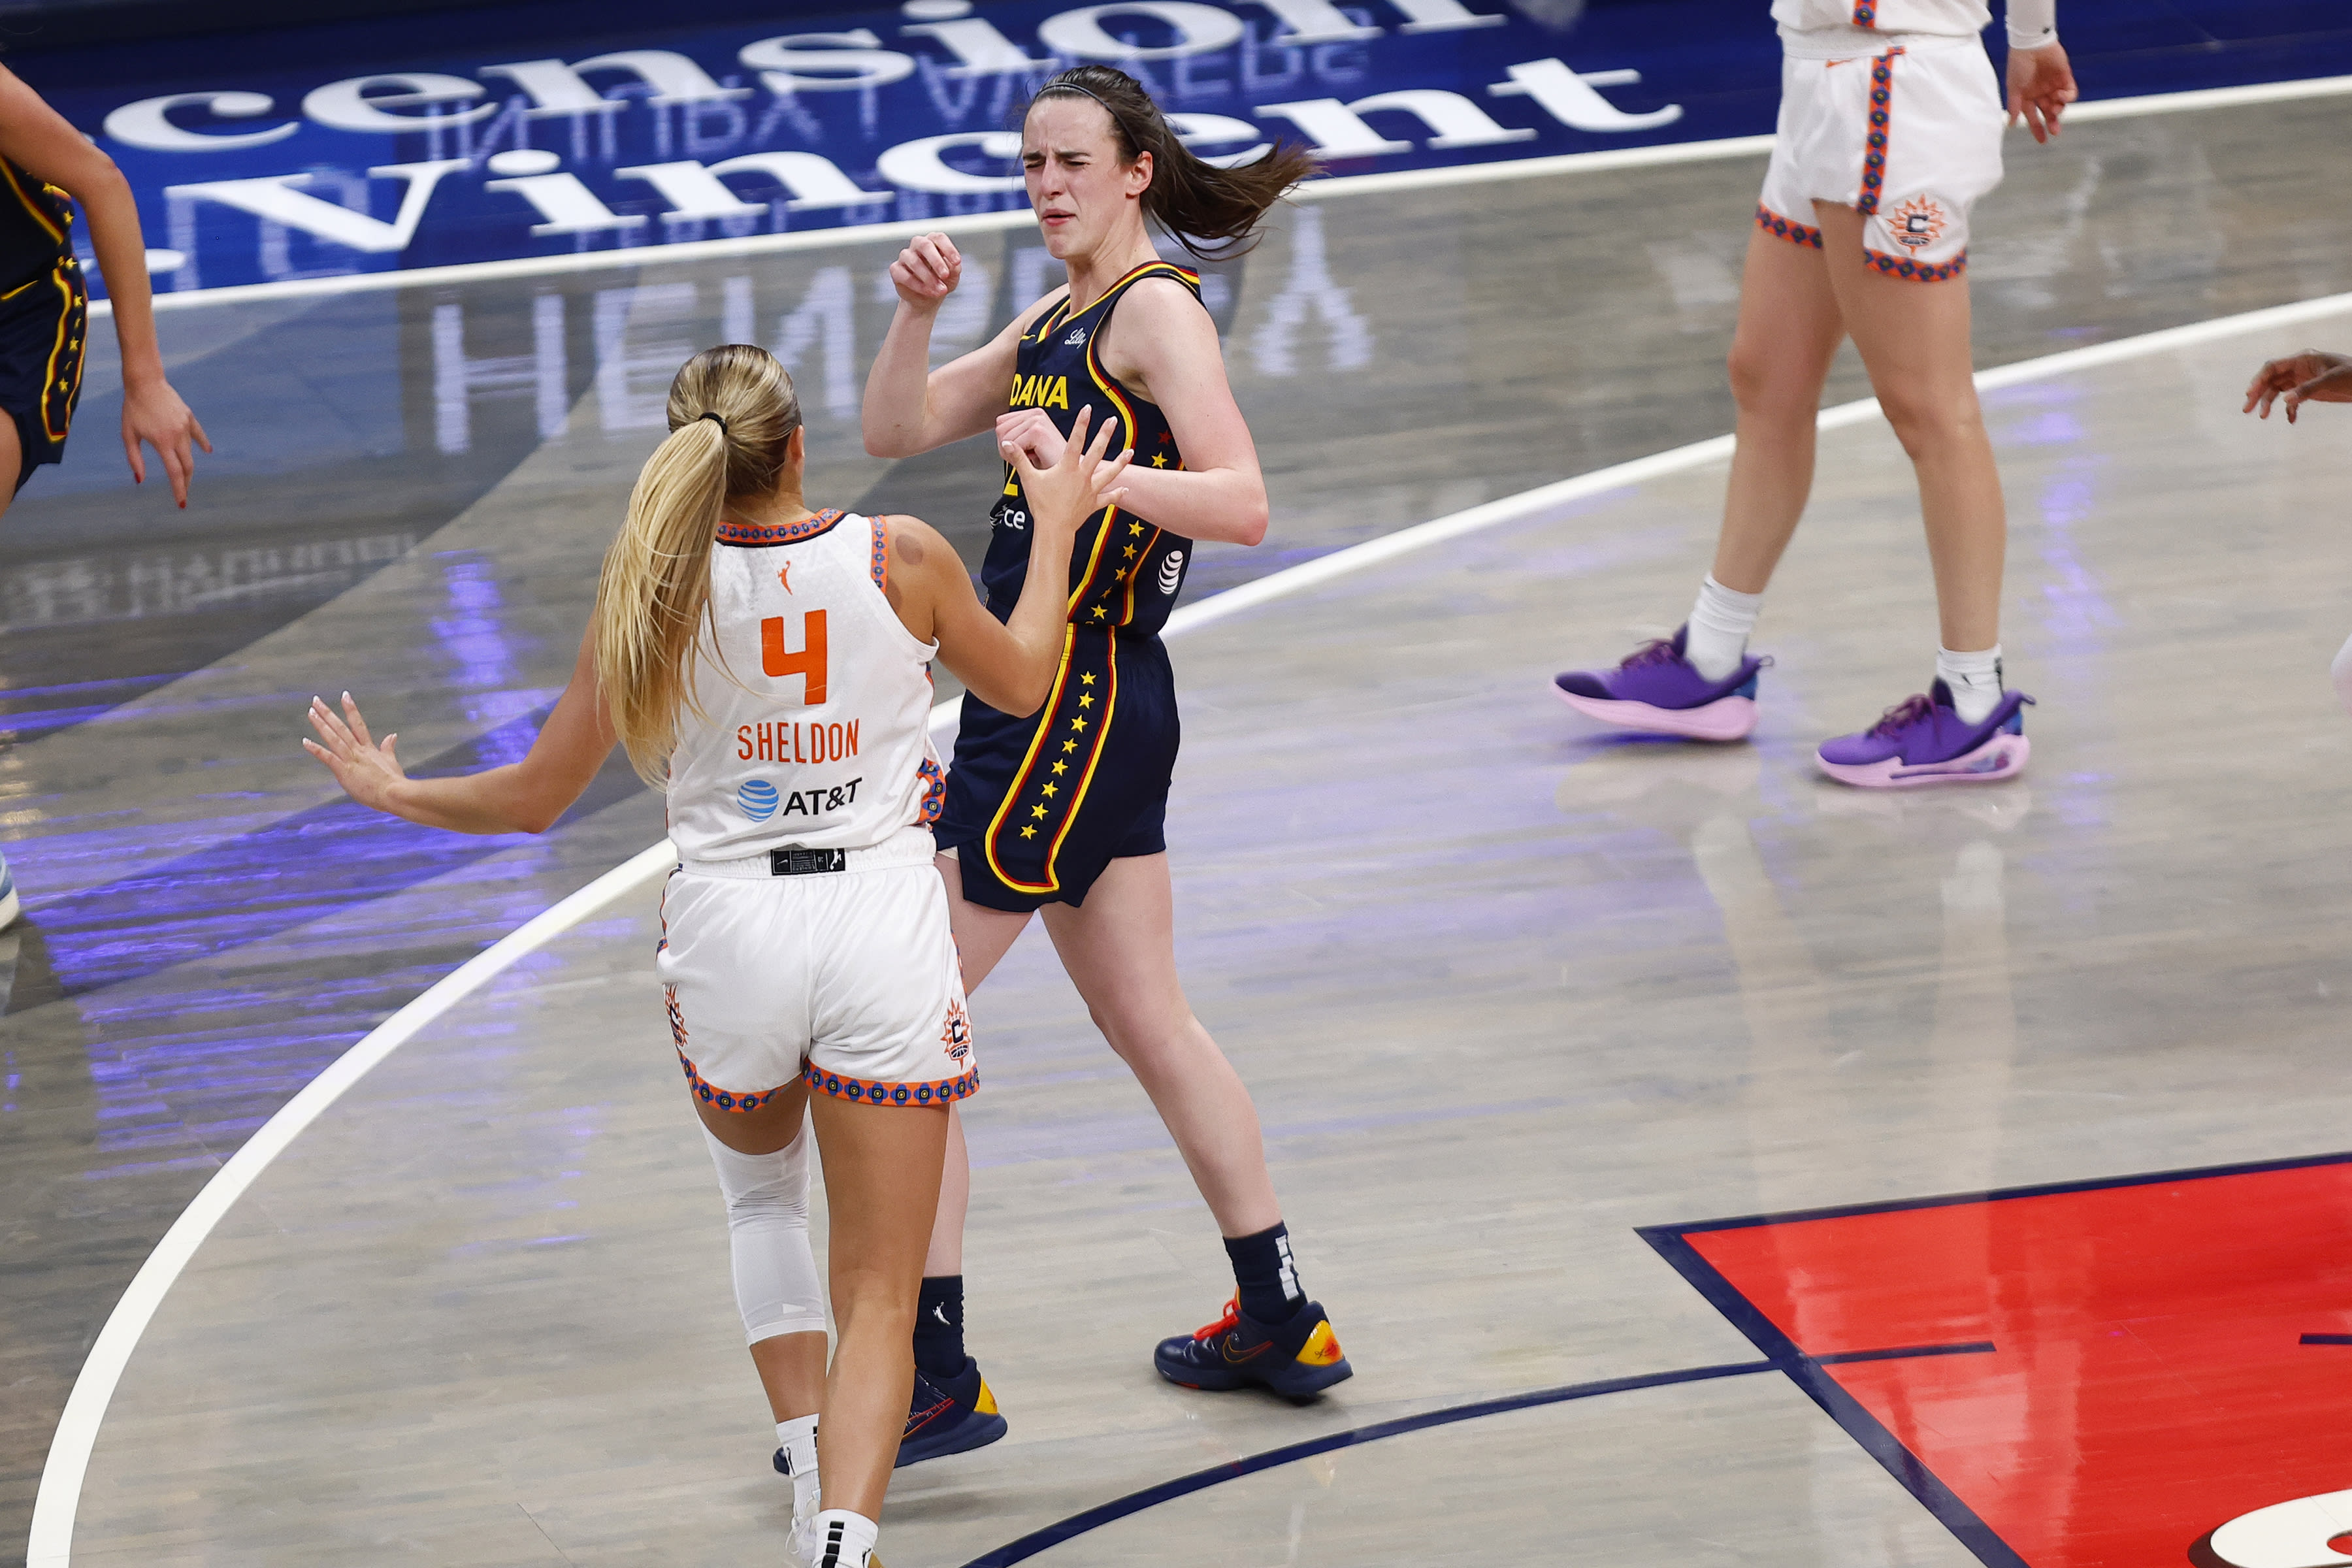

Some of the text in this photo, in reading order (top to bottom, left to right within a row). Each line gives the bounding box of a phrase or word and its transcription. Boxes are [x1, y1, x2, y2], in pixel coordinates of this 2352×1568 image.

[85, 0, 1508, 150] cension
[1064, 327, 1087, 350] Lilly
[760, 608, 827, 706] 4
[737, 718, 860, 764] SHELDON
[783, 777, 863, 816] AT&T
[951, 1019, 964, 1043] C
